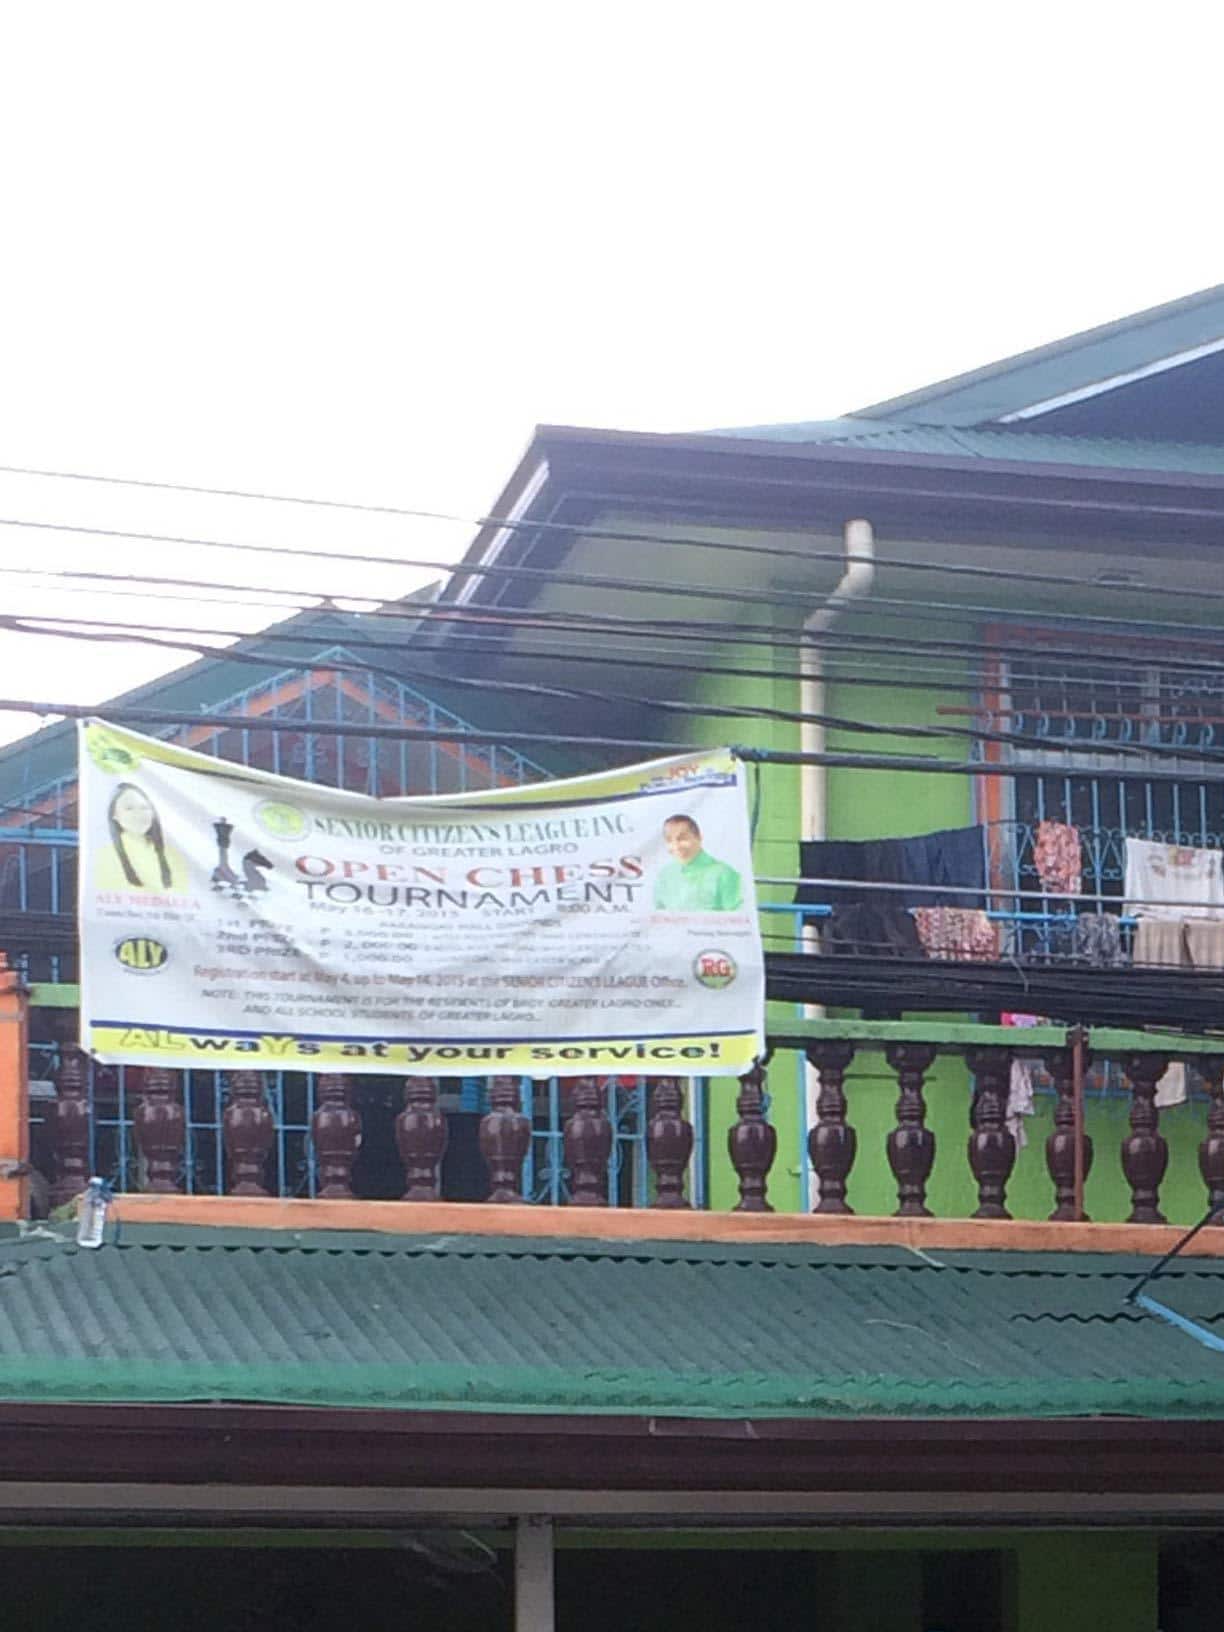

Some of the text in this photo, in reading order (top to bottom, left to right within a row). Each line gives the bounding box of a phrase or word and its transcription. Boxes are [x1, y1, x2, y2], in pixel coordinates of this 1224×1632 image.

[314, 816, 393, 841] SENIOR
[504, 818, 590, 843] LEAGUE
[378, 841, 579, 858] OF GREATER LAGRO
[295, 854, 644, 889] OPEN CHESS
[295, 879, 644, 910] TOURNAMENT
[118, 938, 165, 970] ALY
[339, 1041, 393, 1058] at
[407, 1043, 514, 1062] your
[530, 1042, 722, 1060] service!
